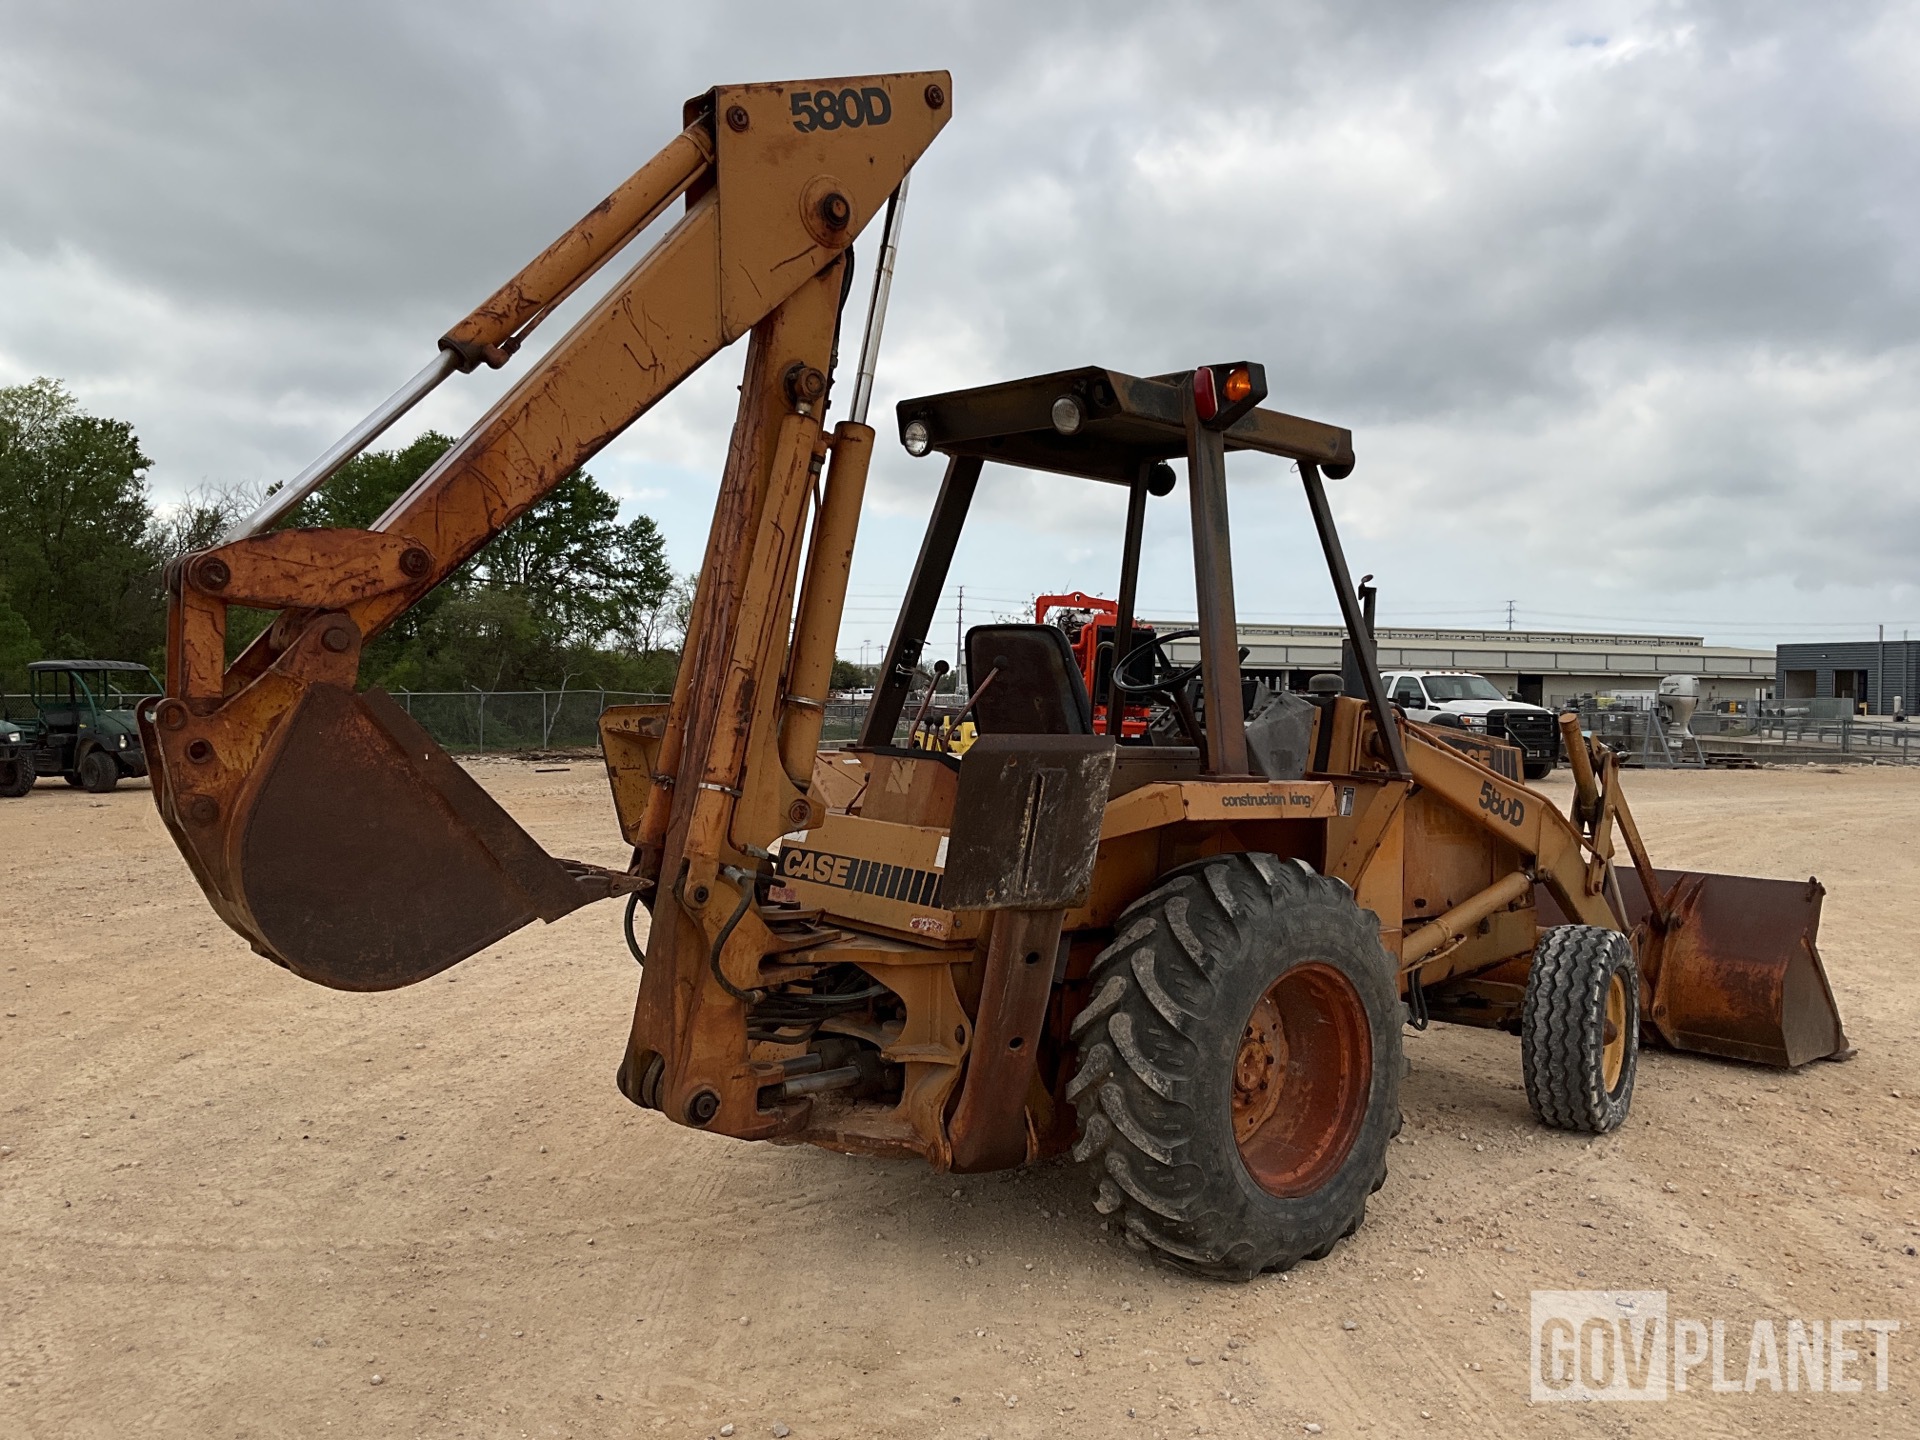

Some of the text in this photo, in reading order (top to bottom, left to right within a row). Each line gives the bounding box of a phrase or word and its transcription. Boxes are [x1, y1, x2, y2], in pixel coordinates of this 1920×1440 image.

[790, 87, 892, 133] 580D
[1222, 791, 1311, 808] construction king
[1478, 780, 1524, 827] 580D
[784, 849, 851, 886] CASE
